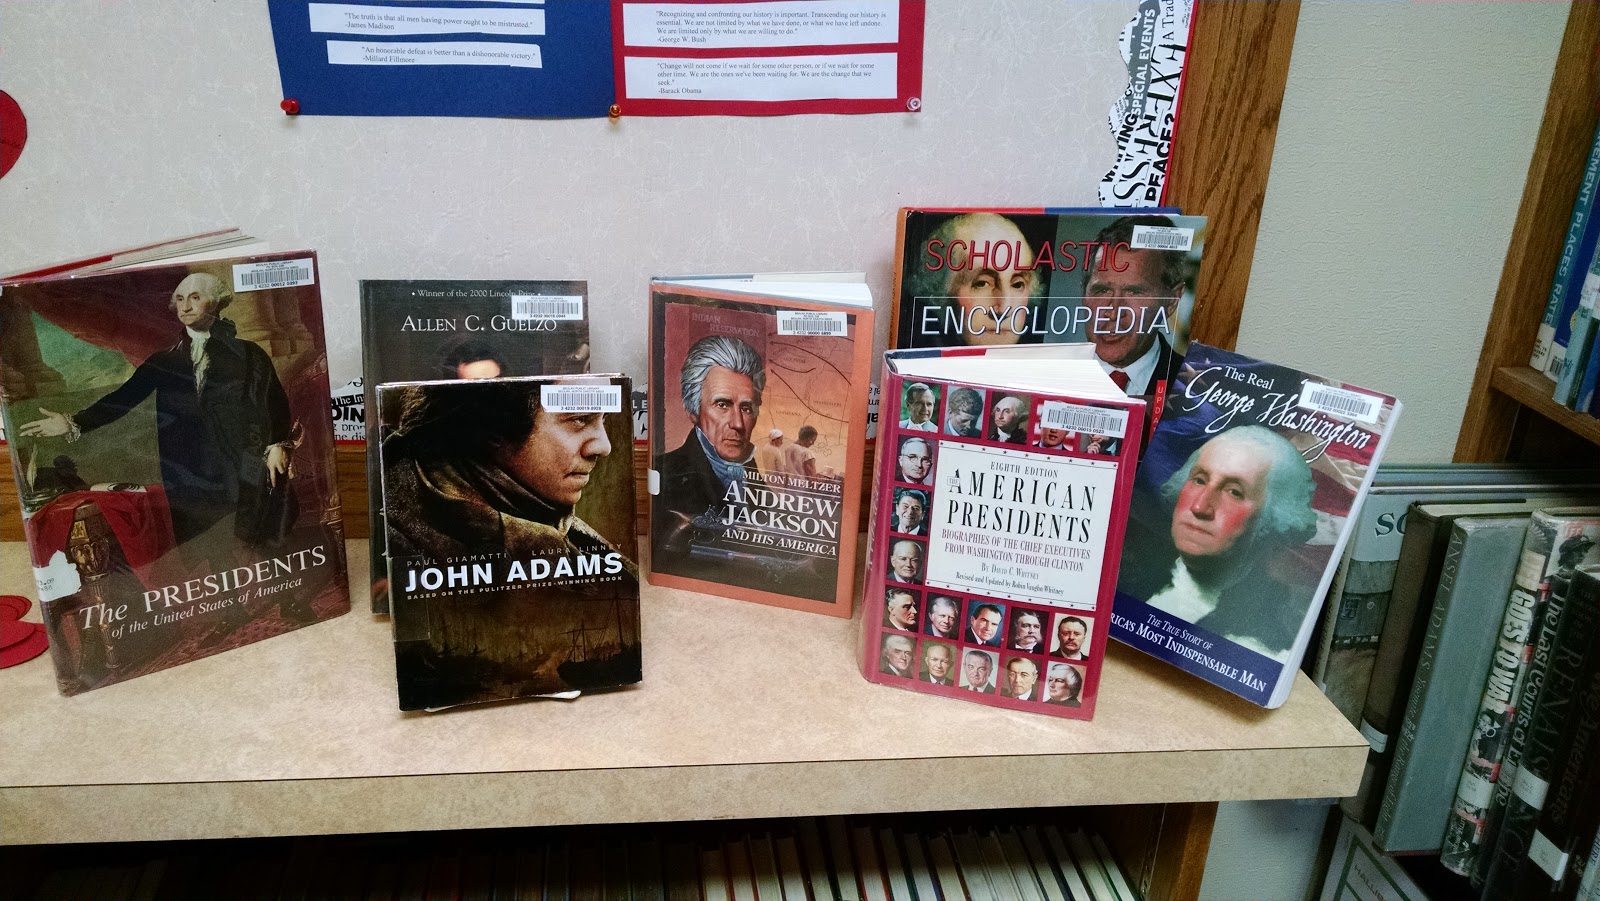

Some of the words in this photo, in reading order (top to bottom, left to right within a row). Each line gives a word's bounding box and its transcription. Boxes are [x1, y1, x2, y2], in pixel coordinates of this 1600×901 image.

[344, 12, 360, 20] "The
[397, 14, 405, 22] all
[421, 16, 442, 25] having
[464, 18, 481, 27] ought
[498, 20, 533, 28] mistrusted."
[368, 22, 395, 30] Madison
[656, 10, 695, 18] "Recognizing
[753, 11, 773, 19] history
[1138, 8, 1156, 60] EVENTS
[376, 46, 406, 54] honorable
[407, 47, 426, 55] defeat
[434, 48, 451, 56] better
[471, 50, 509, 58] dishonorable
[510, 52, 536, 61] victory."
[1131, 63, 1148, 117] SPECIAL
[925, 239, 1132, 273] SCHOLASTIC
[1558, 211, 1584, 277] PLACES
[418, 289, 444, 297] Winner
[447, 289, 454, 297] of
[456, 289, 468, 297] the
[469, 289, 488, 297] 2000
[489, 289, 516, 297] Lincoln
[400, 315, 456, 332] ALLEN
[464, 315, 485, 332] C.
[490, 315, 557, 332] GUELZO
[692, 312, 721, 323] INDIAN
[709, 323, 760, 337] RESERVATION
[920, 304, 1171, 336] ENCYCLOPEDIA
[1224, 365, 1246, 382] The
[1248, 372, 1274, 391] Real
[1182, 367, 1255, 434] George
[1256, 386, 1371, 464] Washington
[742, 470, 785, 486] MILTON
[788, 476, 842, 494] MELTZER
[990, 461, 1021, 474] EIGHTH
[1024, 465, 1059, 479] EDITION
[722, 480, 841, 518] ANDREW
[949, 468, 1097, 512] AMERICAN
[722, 504, 839, 538] JACKSON
[946, 499, 1092, 544] PRESIDENTS
[406, 558, 438, 568] PAUL
[446, 552, 508, 564] GIAMATTI
[531, 547, 572, 556] LAURA
[578, 543, 622, 552] LINNEY
[722, 528, 750, 542] AND
[752, 534, 774, 546] HIS
[776, 537, 836, 556] AMERICA
[942, 528, 990, 546] BIOGRAPHIES
[992, 536, 1002, 546] OF
[1003, 538, 1018, 549] THE
[1020, 540, 1043, 554] CHIEF
[1044, 544, 1091, 560] EXECUTIVES
[944, 542, 966, 554] FROM
[966, 546, 1014, 562] WASHINGTON
[1015, 553, 1050, 568] THROUGH
[1051, 558, 1084, 573] CLINTON
[405, 562, 493, 592] JOHN
[506, 552, 624, 583] ADAMS
[1016, 567, 1039, 580] WHITNEY
[1440, 532, 1463, 592] ANSEL
[79, 601, 128, 631] The
[142, 544, 327, 614] PRESIDENTS
[407, 592, 437, 600] BASED
[458, 588, 474, 596] THE
[479, 584, 522, 594] PULITZER
[526, 577, 596, 590] PRIZE-WINNING
[956, 572, 974, 582] Revised
[975, 575, 984, 583] and
[985, 576, 1004, 587] Updated
[1005, 580, 1011, 588] by
[1012, 581, 1025, 589] Robin
[1044, 585, 1064, 596] Whitney
[111, 626, 126, 640] of
[129, 619, 148, 634] the
[153, 608, 194, 627] United
[198, 596, 234, 615] States
[238, 590, 252, 604] of
[253, 577, 302, 600] America
[1503, 589, 1536, 644] GOES
[1545, 591, 1566, 625] The
[1147, 614, 1160, 628] THE
[1162, 620, 1180, 636] TRUE
[1180, 629, 1203, 646] STORY
[1203, 641, 1213, 651] OF
[1421, 600, 1445, 670] ADAMS
[1534, 625, 1557, 666] Last
[1136, 623, 1165, 646] MOST
[1165, 636, 1239, 680] INDISPENSABLE
[1238, 669, 1268, 693] MAN
[1496, 638, 1525, 670] TO
[1483, 667, 1516, 715] WAR
[1518, 667, 1545, 729] Courts
[1512, 726, 1526, 746] of
